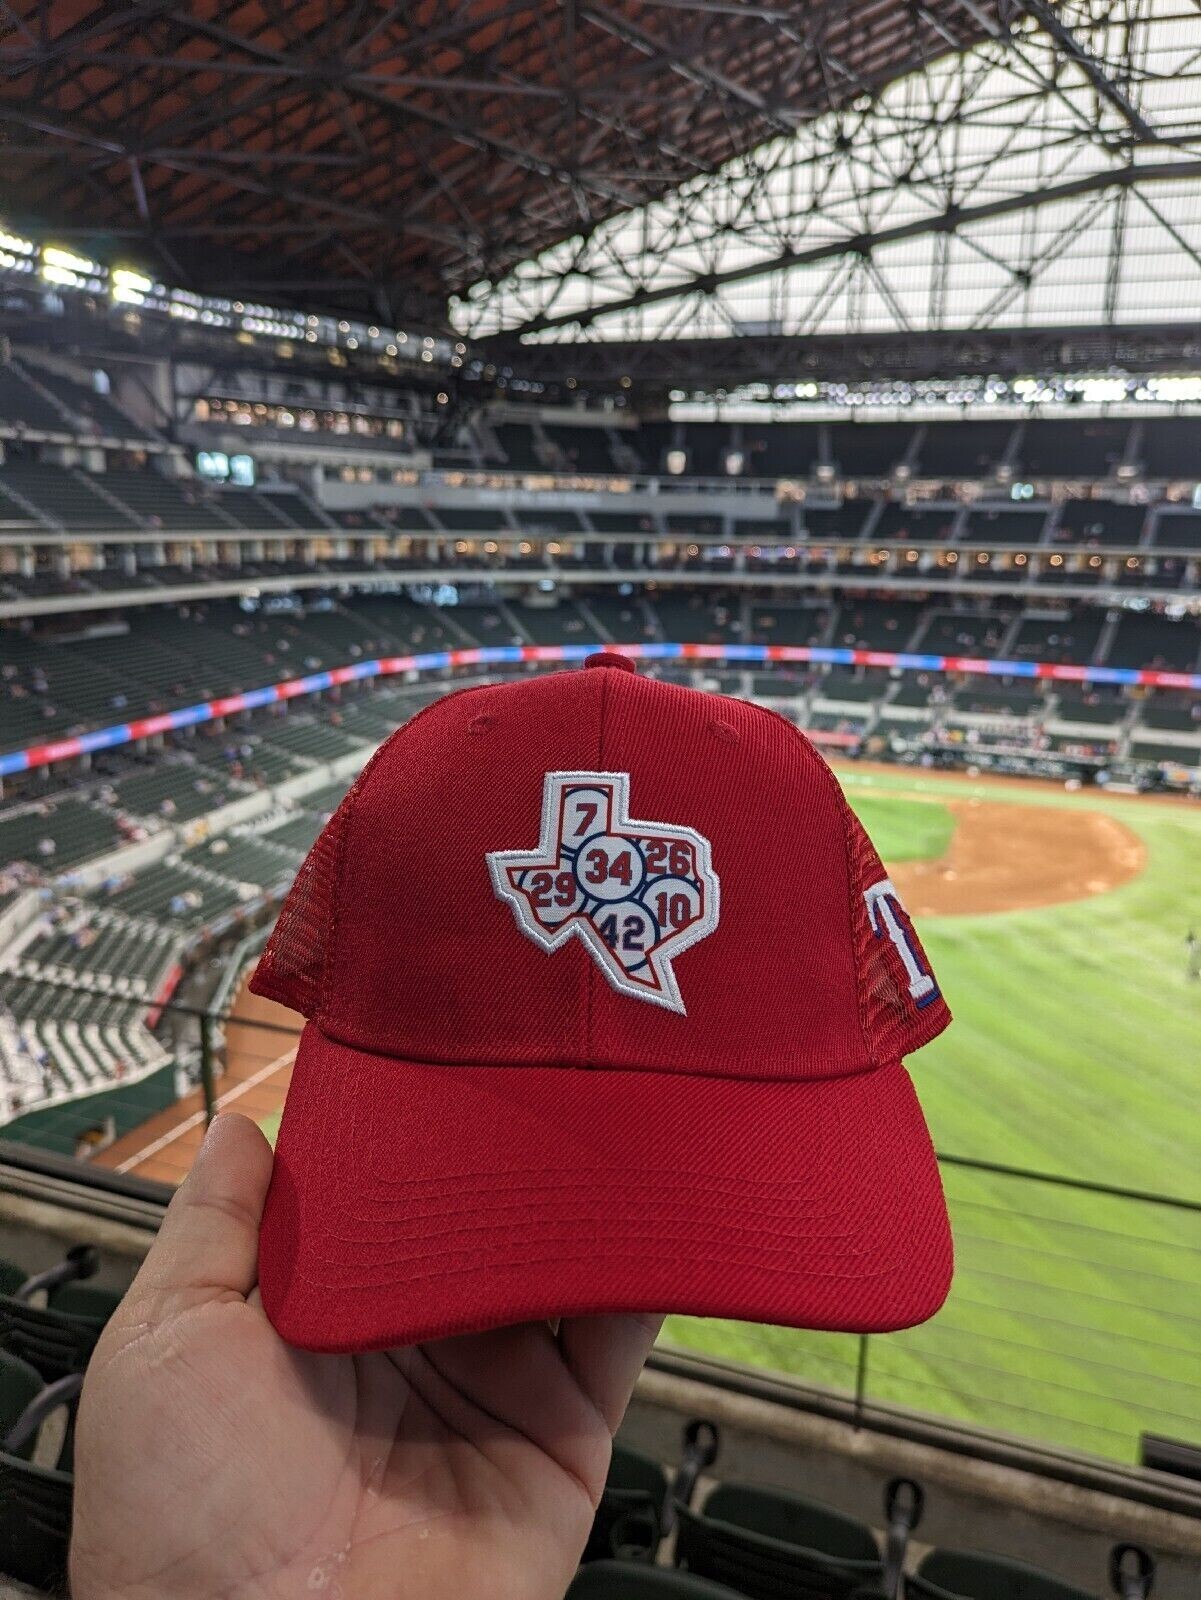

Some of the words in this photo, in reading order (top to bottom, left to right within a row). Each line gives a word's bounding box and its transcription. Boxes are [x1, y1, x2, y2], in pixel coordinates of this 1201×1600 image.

[572, 803, 598, 836] 7
[584, 848, 633, 886] 34
[645, 841, 691, 877] 26
[529, 872, 577, 908] 29
[654, 892, 691, 928] 10
[600, 913, 646, 950] 42
